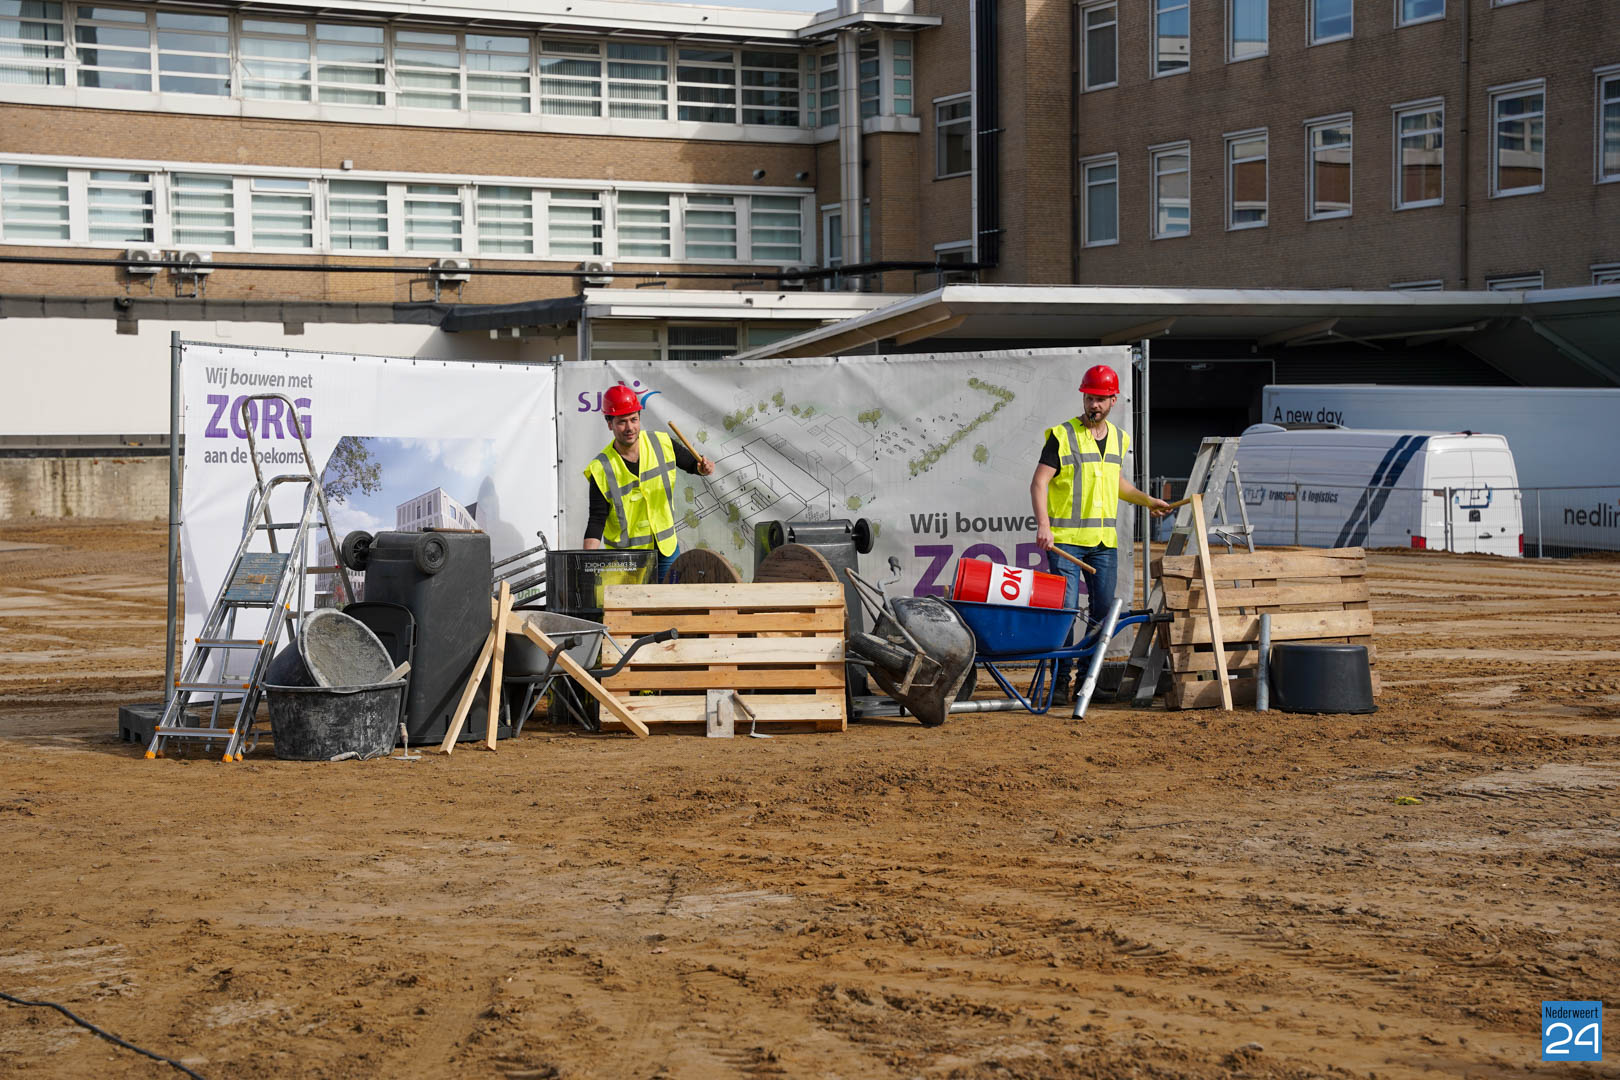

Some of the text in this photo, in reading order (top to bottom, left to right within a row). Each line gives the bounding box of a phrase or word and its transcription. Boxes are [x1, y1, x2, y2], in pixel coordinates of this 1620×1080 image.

[205, 366, 313, 389] Wij bouwen met
[577, 391, 603, 412] SJ
[204, 393, 312, 440] ZORG
[1273, 405, 1283, 422] A
[1286, 409, 1313, 423] new
[204, 446, 305, 464] aan de oekoms
[1268, 489, 1339, 504] trans & logistics
[909, 511, 1038, 539] Wij bouwe
[1000, 566, 1023, 601] OK
